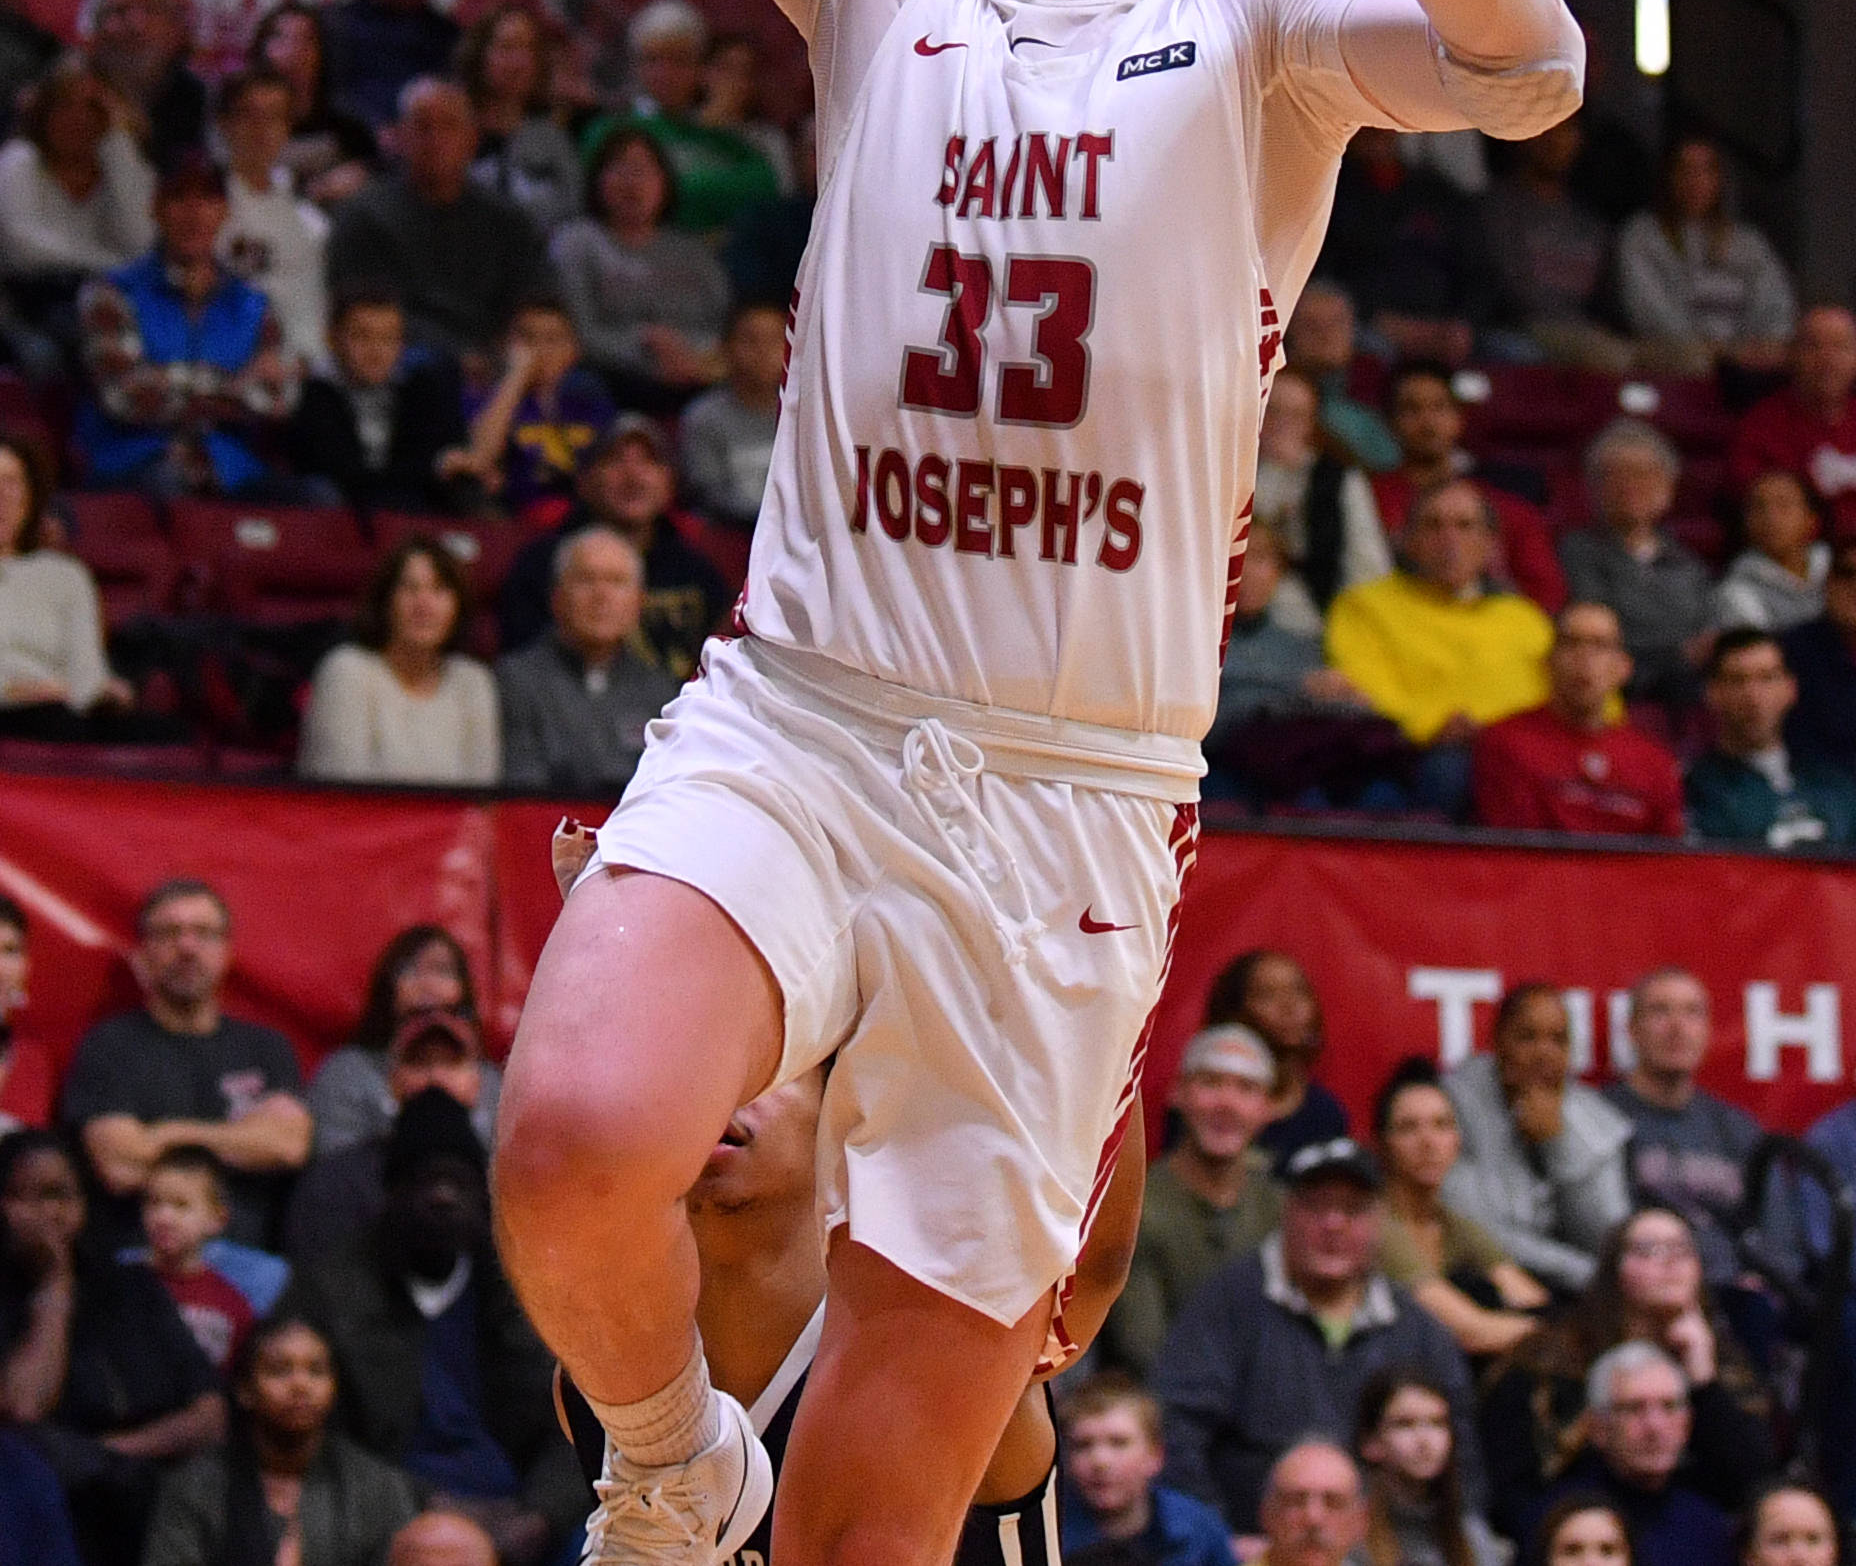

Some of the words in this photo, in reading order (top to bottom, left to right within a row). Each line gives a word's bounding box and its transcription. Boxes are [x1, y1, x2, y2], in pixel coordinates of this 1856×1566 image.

[934, 128, 1115, 221] SAINT
[897, 241, 1097, 430] 33
[850, 444, 1145, 573] JOSEPH'S
